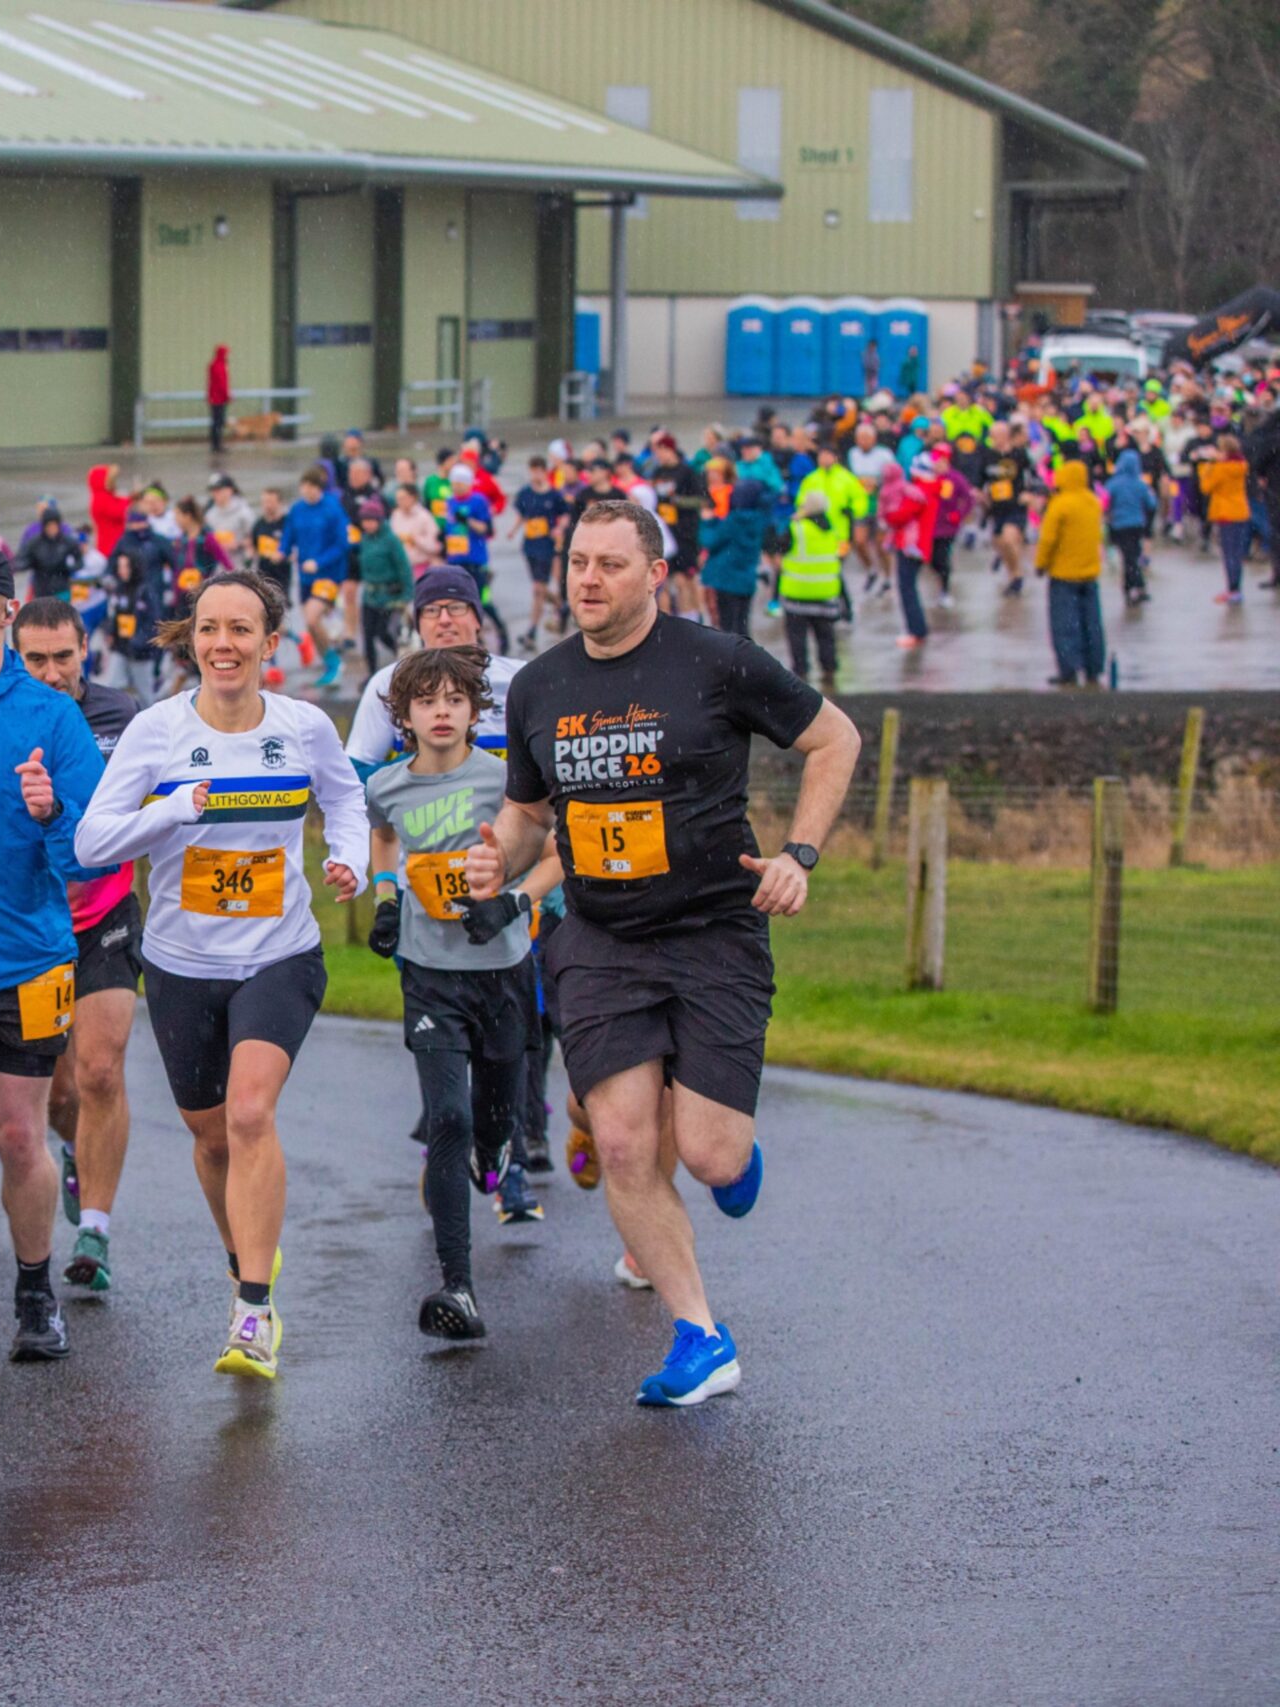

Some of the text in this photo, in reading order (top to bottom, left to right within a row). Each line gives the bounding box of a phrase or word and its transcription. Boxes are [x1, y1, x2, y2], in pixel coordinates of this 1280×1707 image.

[555, 713, 588, 739] 5K
[589, 710, 624, 736] Simon
[554, 730, 665, 762] PUDDIN'
[555, 753, 662, 783] RACE 26
[204, 792, 292, 808] LITHGOW AC
[600, 826, 625, 853] 15
[211, 868, 254, 894] 346
[435, 871, 470, 896] 138
[56, 983, 72, 1011] 14
